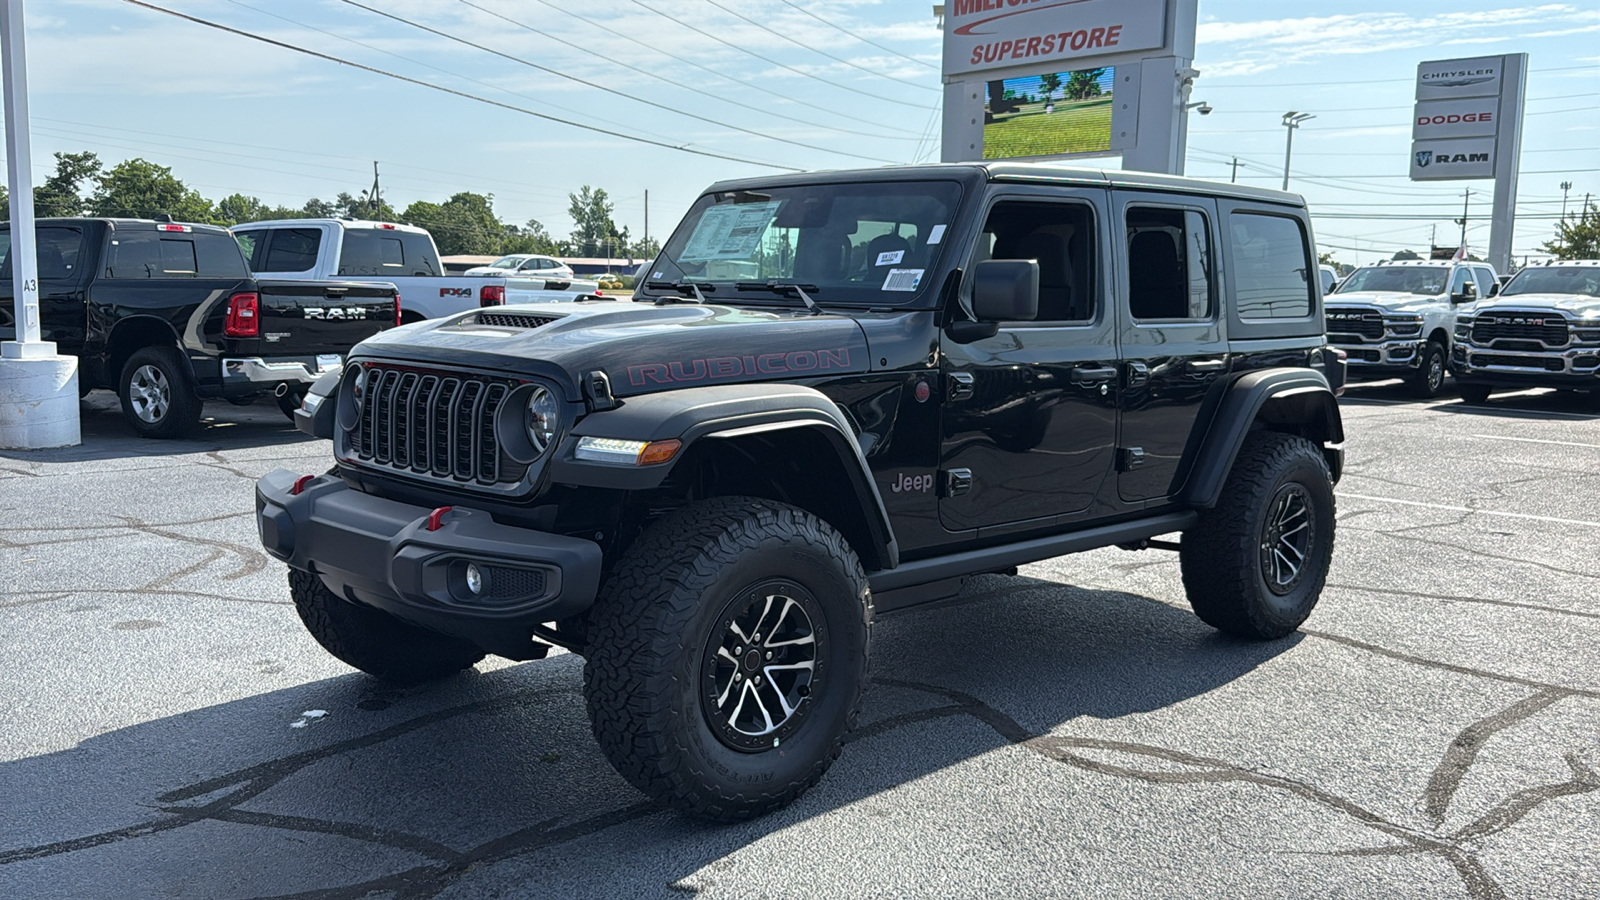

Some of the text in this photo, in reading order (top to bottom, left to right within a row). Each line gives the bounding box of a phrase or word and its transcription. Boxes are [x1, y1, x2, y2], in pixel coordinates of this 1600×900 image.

[970, 25, 1123, 65] SUPERSTORE
[1422, 69, 1494, 79] CHRYSLER
[1417, 112, 1492, 125] DODGE
[1435, 153, 1489, 163] RAM
[24, 279, 37, 291] A3
[439, 287, 473, 298] FX4
[303, 307, 366, 319] RAM
[1496, 317, 1543, 326] RAM
[627, 348, 851, 386] RUBICON
[891, 473, 933, 493] Jeep
